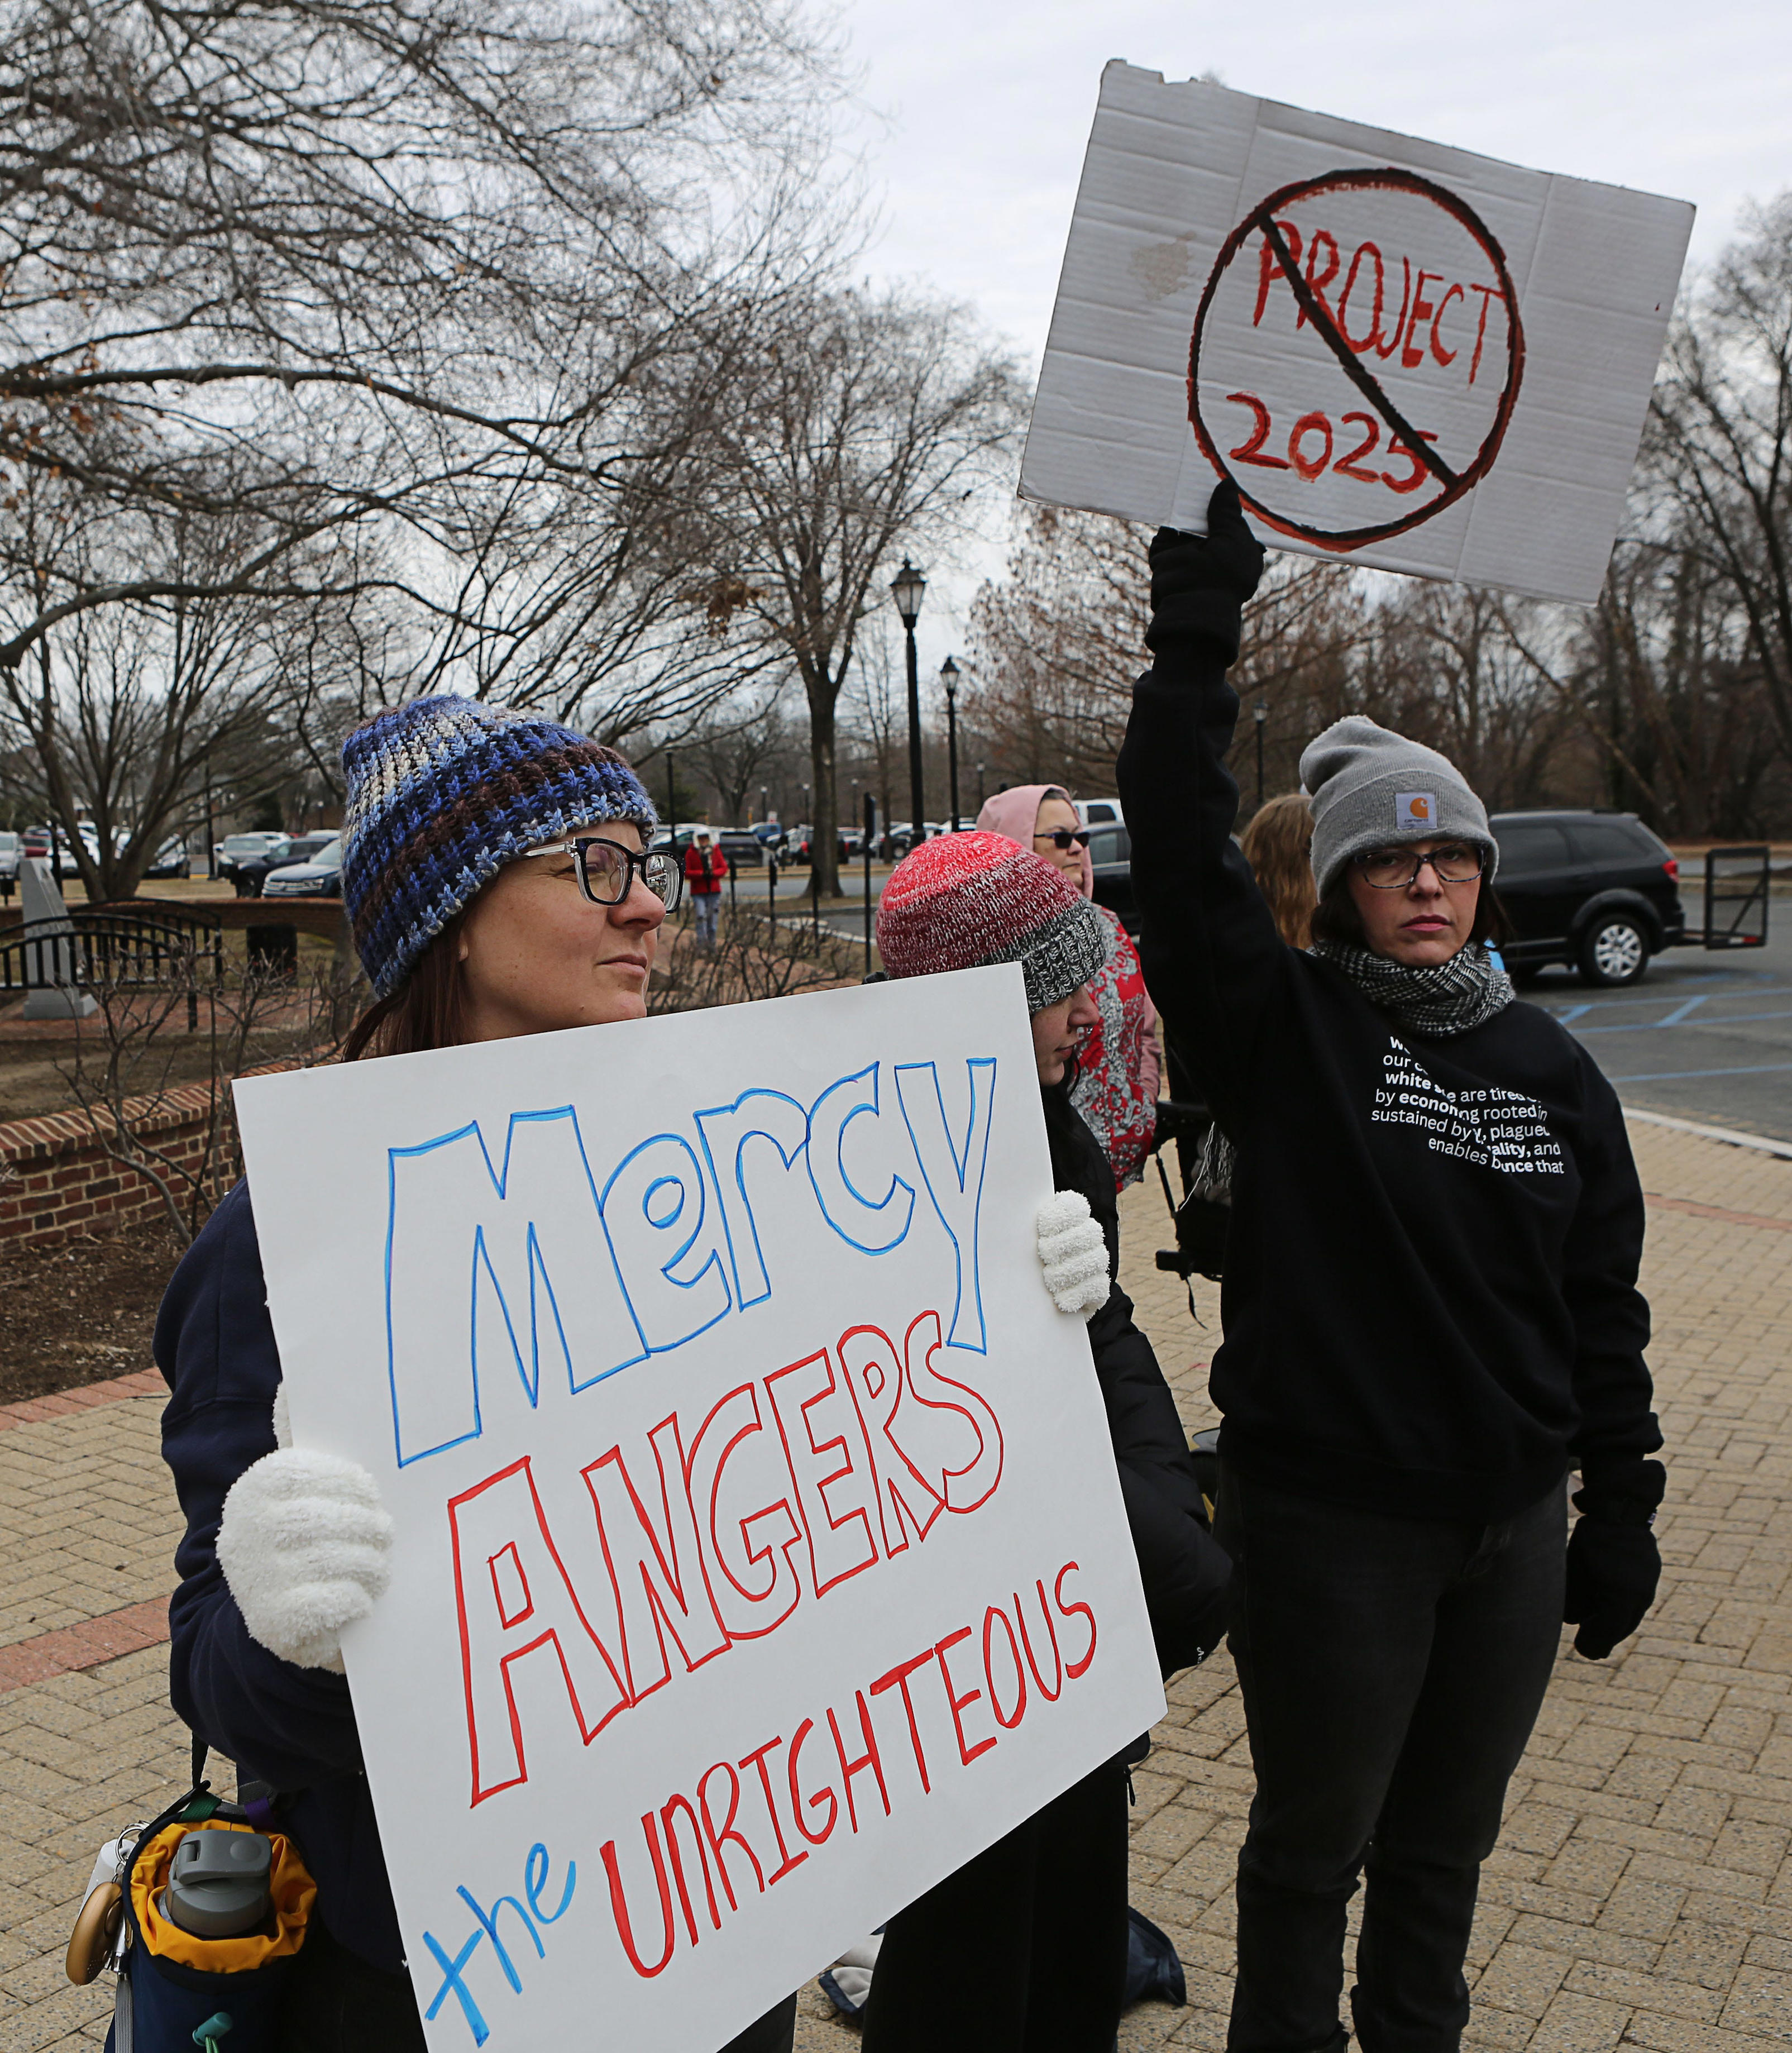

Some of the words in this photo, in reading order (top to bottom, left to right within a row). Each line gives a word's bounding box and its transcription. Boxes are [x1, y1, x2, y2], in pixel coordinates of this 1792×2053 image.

[1253, 221, 1506, 390] PROJECT
[1226, 391, 1438, 494] 2025
[1383, 1054, 1411, 1067] our
[1385, 1071, 1431, 1090] white
[1375, 1088, 1396, 1106] by
[1460, 1090, 1487, 1102] are
[1484, 1105, 1537, 1120] rooted
[1537, 1105, 1548, 1121] in
[1371, 1109, 1448, 1133] sustained
[1451, 1121, 1473, 1142] by
[1428, 1138, 1488, 1165] enables
[1534, 1142, 1561, 1156] and
[1535, 1159, 1564, 1174] that
[385, 1058, 997, 1468] Mercy
[448, 1310, 1003, 1808] ANGERS
[423, 1842, 576, 2047] the
